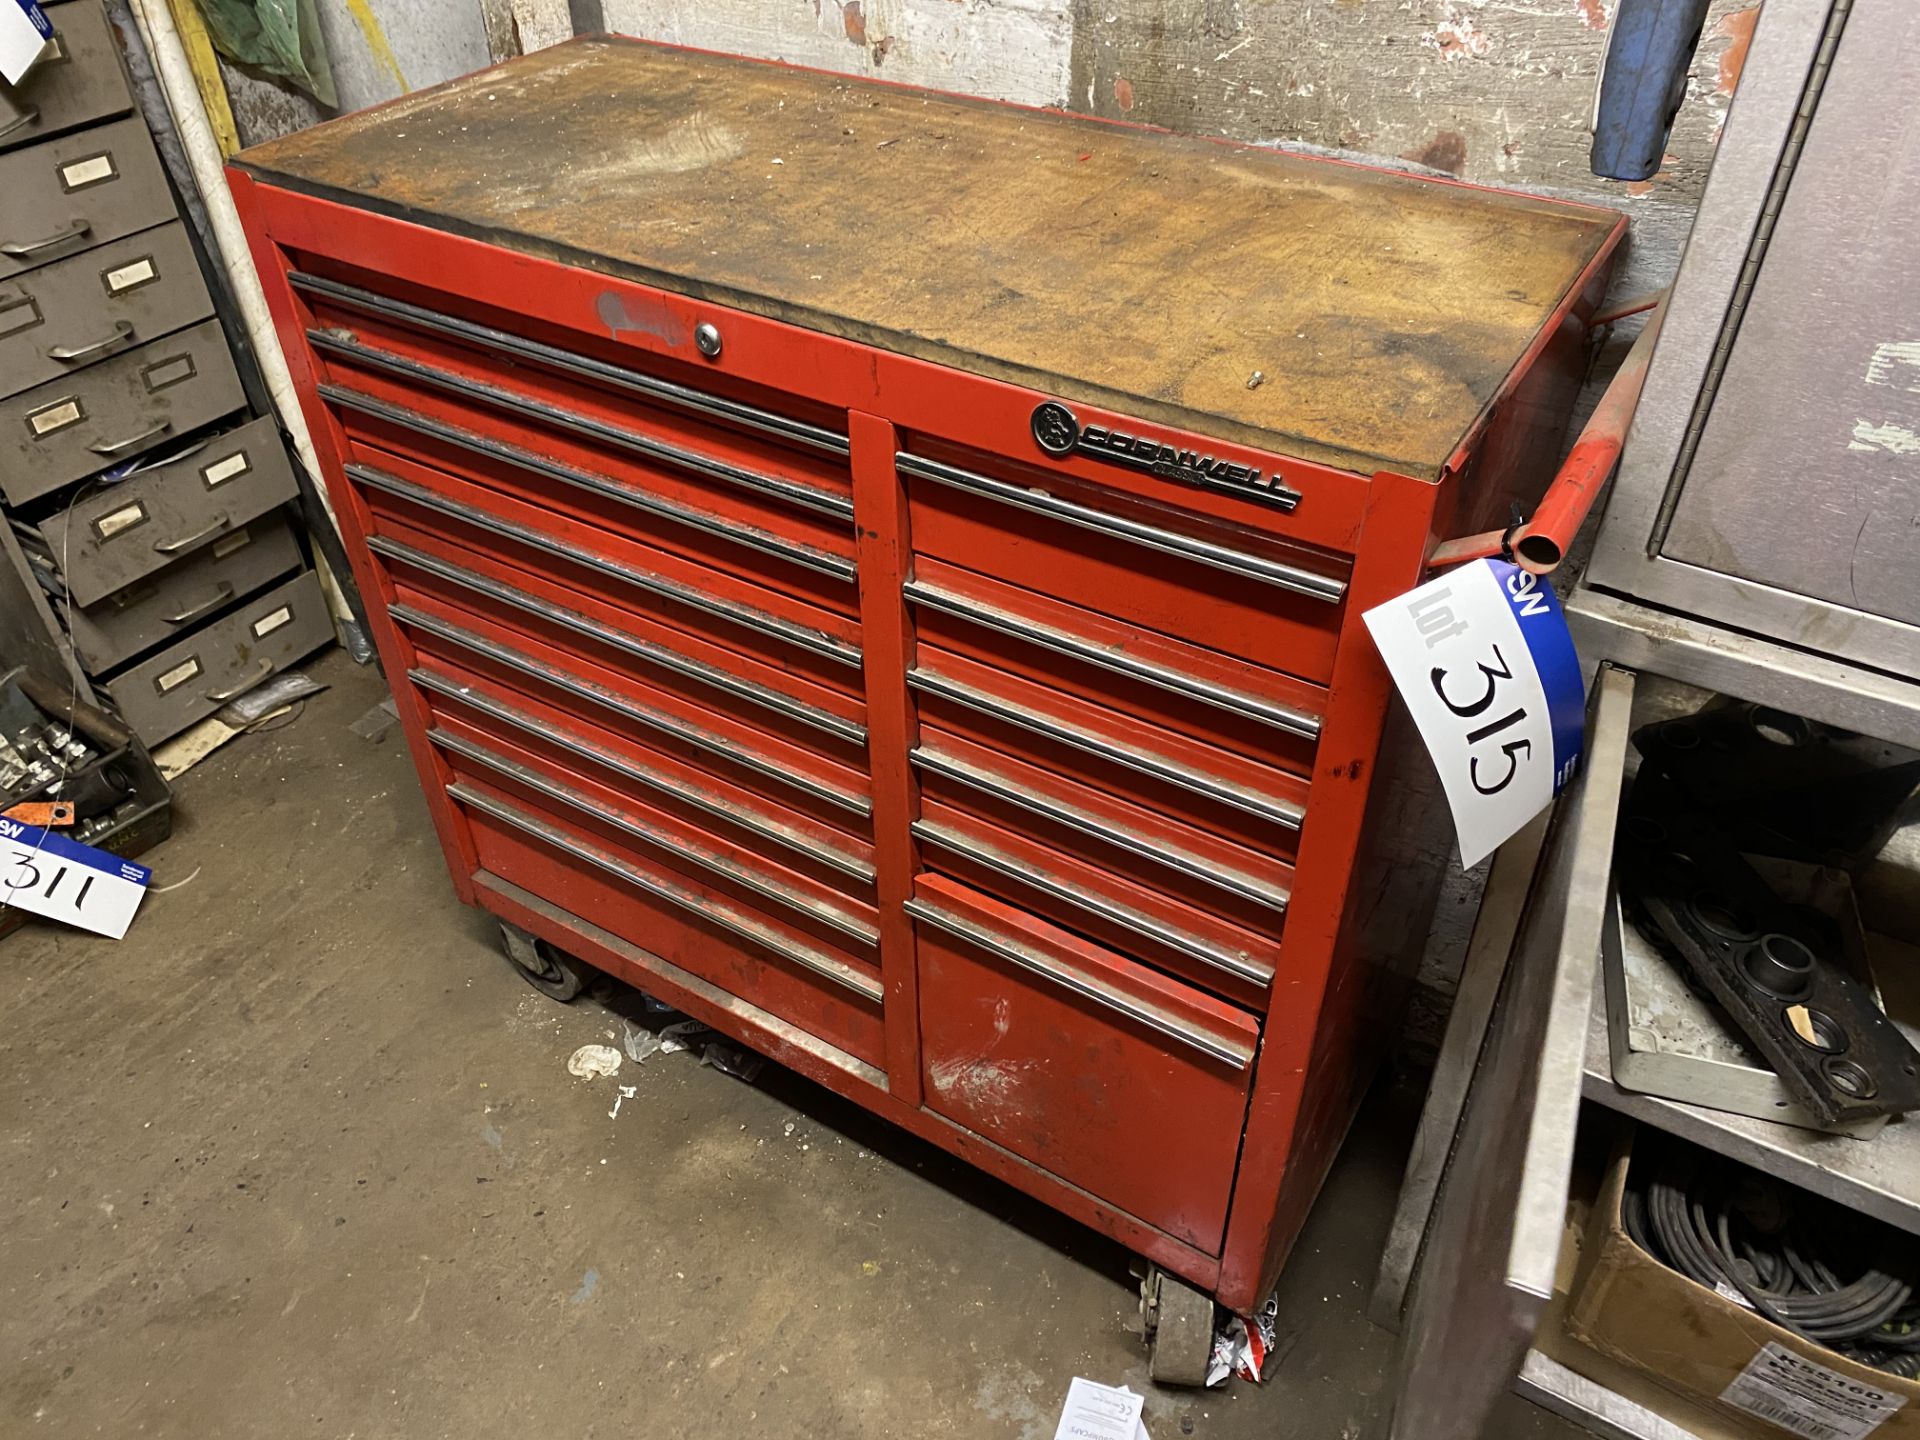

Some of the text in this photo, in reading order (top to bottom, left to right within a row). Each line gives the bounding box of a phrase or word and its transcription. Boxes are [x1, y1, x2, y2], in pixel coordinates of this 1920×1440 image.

[1082, 423, 1288, 495] CORNWELL
[1406, 586, 1470, 651] Lot
[1430, 643, 1531, 796] 315
[4, 851, 95, 912] 311
[1779, 1354, 1884, 1402] K5516D
